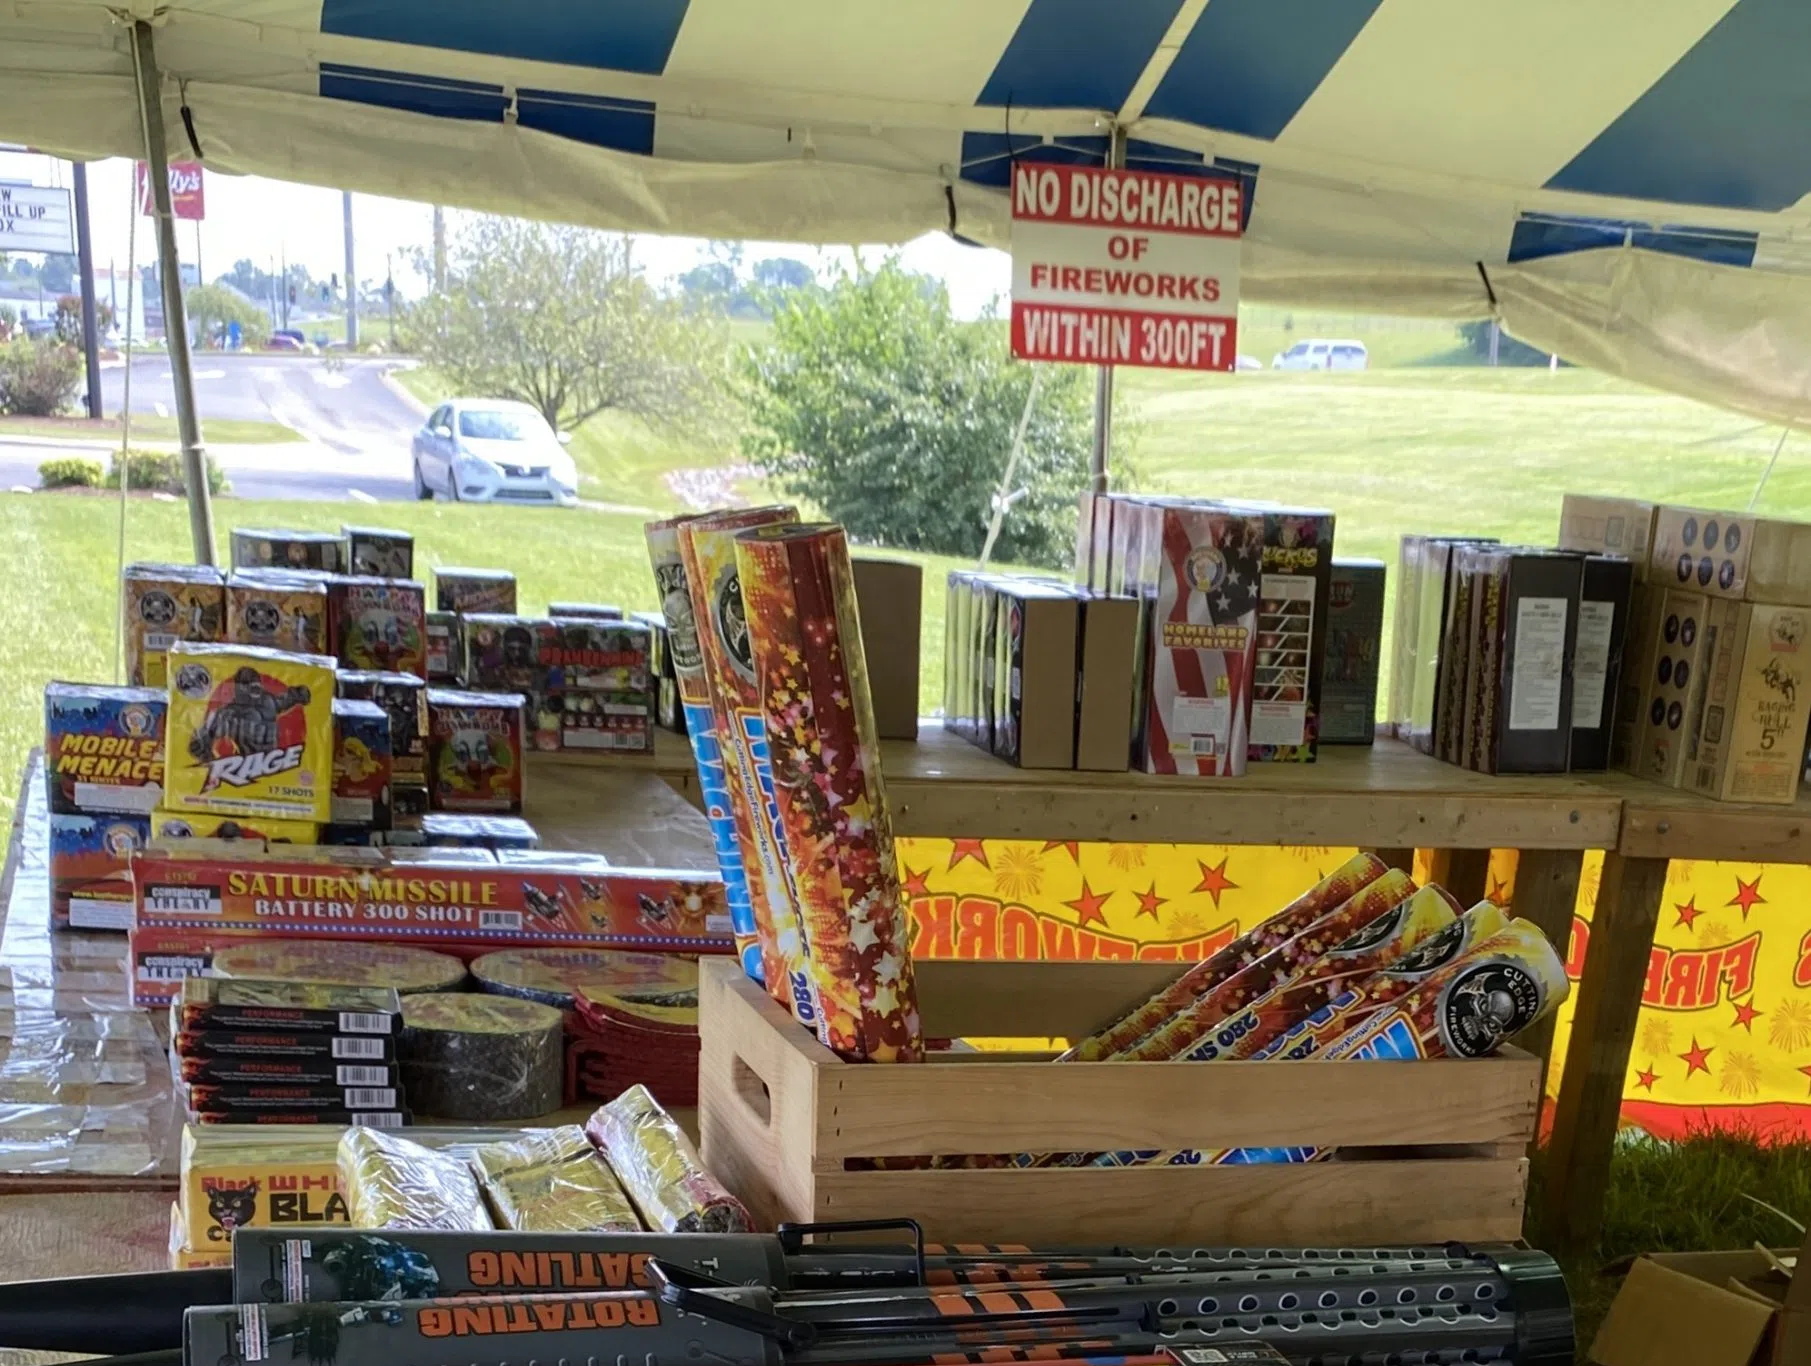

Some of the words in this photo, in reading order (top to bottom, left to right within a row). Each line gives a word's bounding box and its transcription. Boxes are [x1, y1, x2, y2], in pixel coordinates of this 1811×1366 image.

[29, 207, 46, 219] UP
[1016, 168, 1061, 217] NO
[1071, 174, 1240, 231] DISCHARGE
[1108, 236, 1149, 261] OF
[1031, 265, 1220, 302] FIREWORKS
[1023, 309, 1131, 361] WITHIN
[1141, 320, 1227, 363] 300FT
[1163, 623, 1248, 640] HOMELAND
[1164, 636, 1246, 650] FAVORITES
[61, 734, 158, 759] MOBILE
[57, 757, 164, 779] MENACE
[206, 746, 302, 790] RAGE
[268, 786, 280, 797] 17
[282, 787, 315, 798] SHOTS
[228, 872, 355, 900] SATURN
[368, 876, 499, 906] MISSILE
[255, 899, 356, 919] BATTERY
[362, 903, 408, 921] 300
[415, 905, 474, 922] SHOT
[786, 967, 816, 1023] 280
[1503, 967, 1539, 1021] CUTTING
[1507, 980, 1527, 1015] EDGE
[1221, 1011, 1261, 1047] 280
[1449, 1005, 1477, 1055] FIREWORKS
[201, 1176, 262, 1193] Black
[418, 1300, 661, 1338] ROTATING
